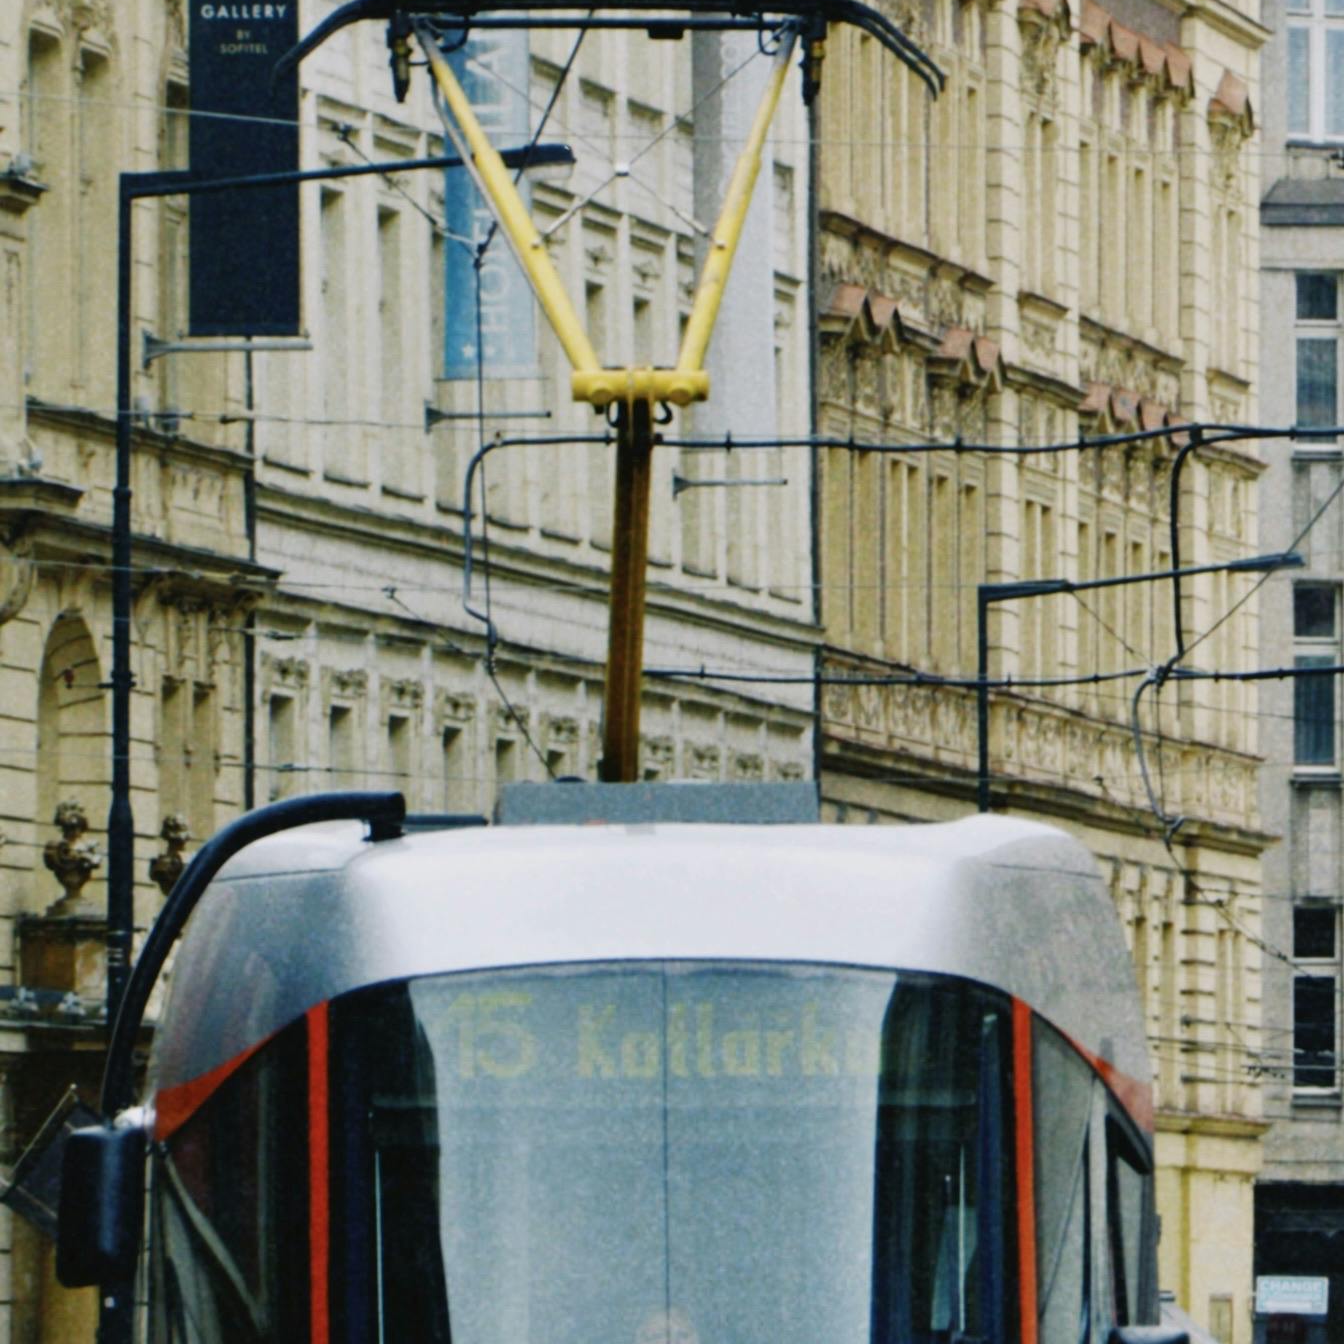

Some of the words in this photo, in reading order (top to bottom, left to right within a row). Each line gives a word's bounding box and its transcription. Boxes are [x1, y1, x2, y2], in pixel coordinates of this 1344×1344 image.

[200, 3, 287, 19] GALLERY
[235, 28, 251, 41] BY
[219, 42, 269, 55] SOFITEL
